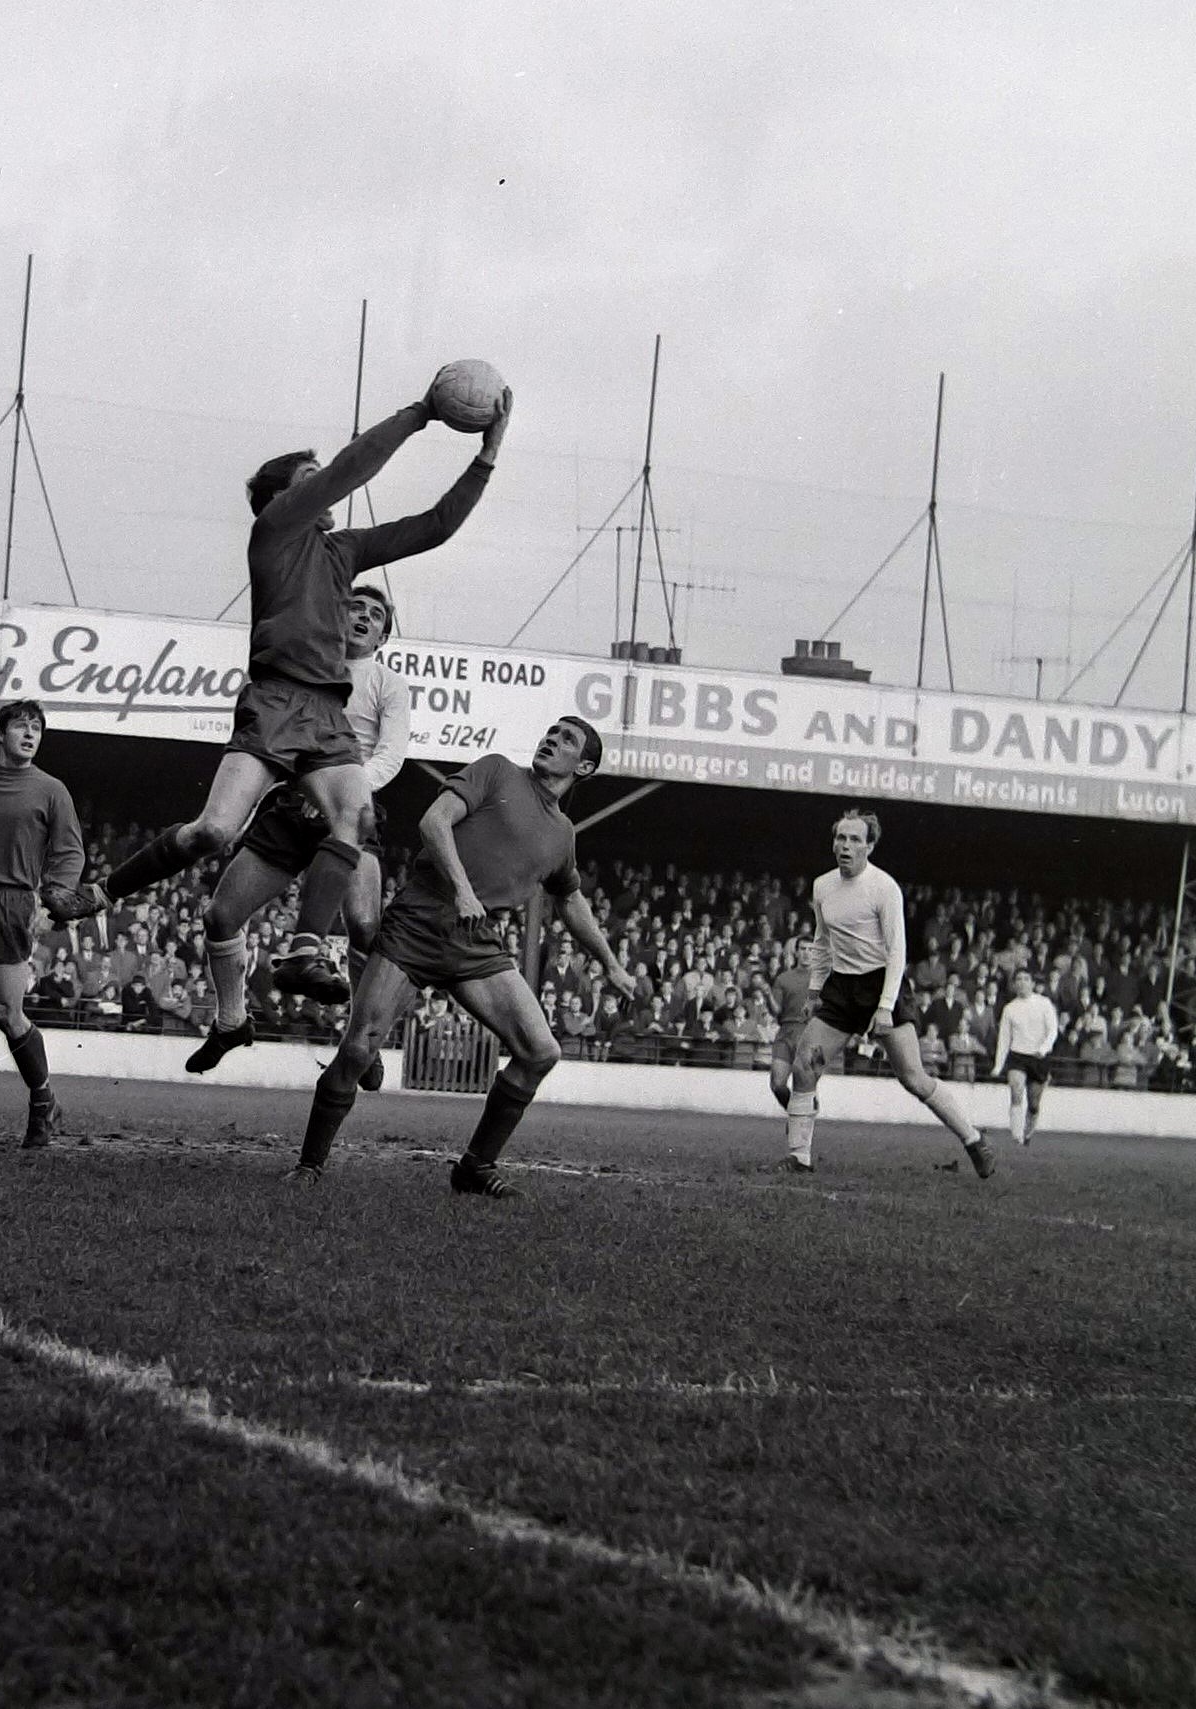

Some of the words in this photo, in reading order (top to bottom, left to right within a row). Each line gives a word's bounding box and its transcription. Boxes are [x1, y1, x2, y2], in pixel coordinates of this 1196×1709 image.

[481, 659, 546, 687] ROAD
[574, 672, 779, 737] GIBBS
[804, 709, 917, 751] AND
[765, 758, 815, 784] and
[953, 769, 1079, 807] Merchants
[1116, 783, 1187, 818] Luton
